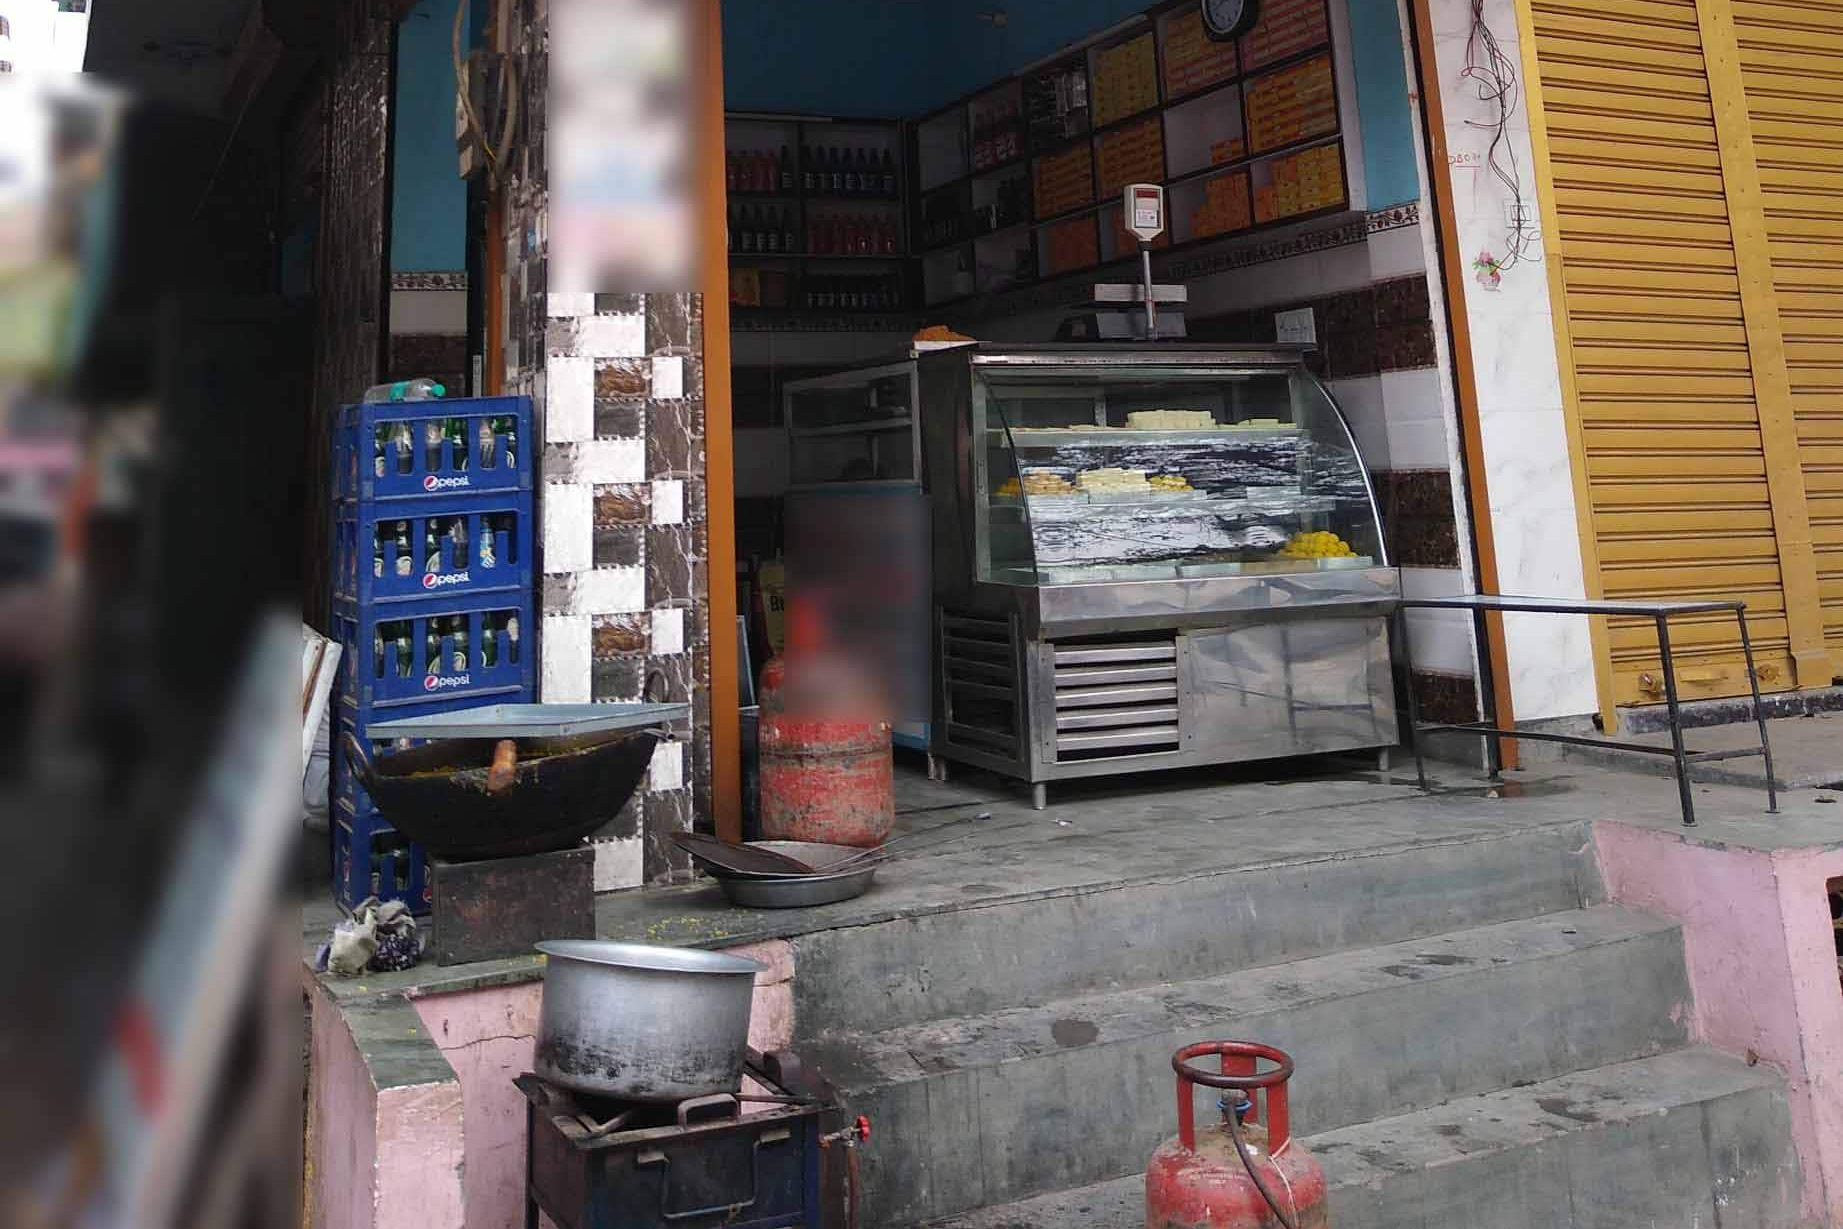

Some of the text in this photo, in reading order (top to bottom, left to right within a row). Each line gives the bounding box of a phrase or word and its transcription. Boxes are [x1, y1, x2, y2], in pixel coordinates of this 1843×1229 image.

[438, 475, 470, 489] pepsi
[438, 571, 470, 586] pepsi
[438, 674, 470, 688] pepsi
